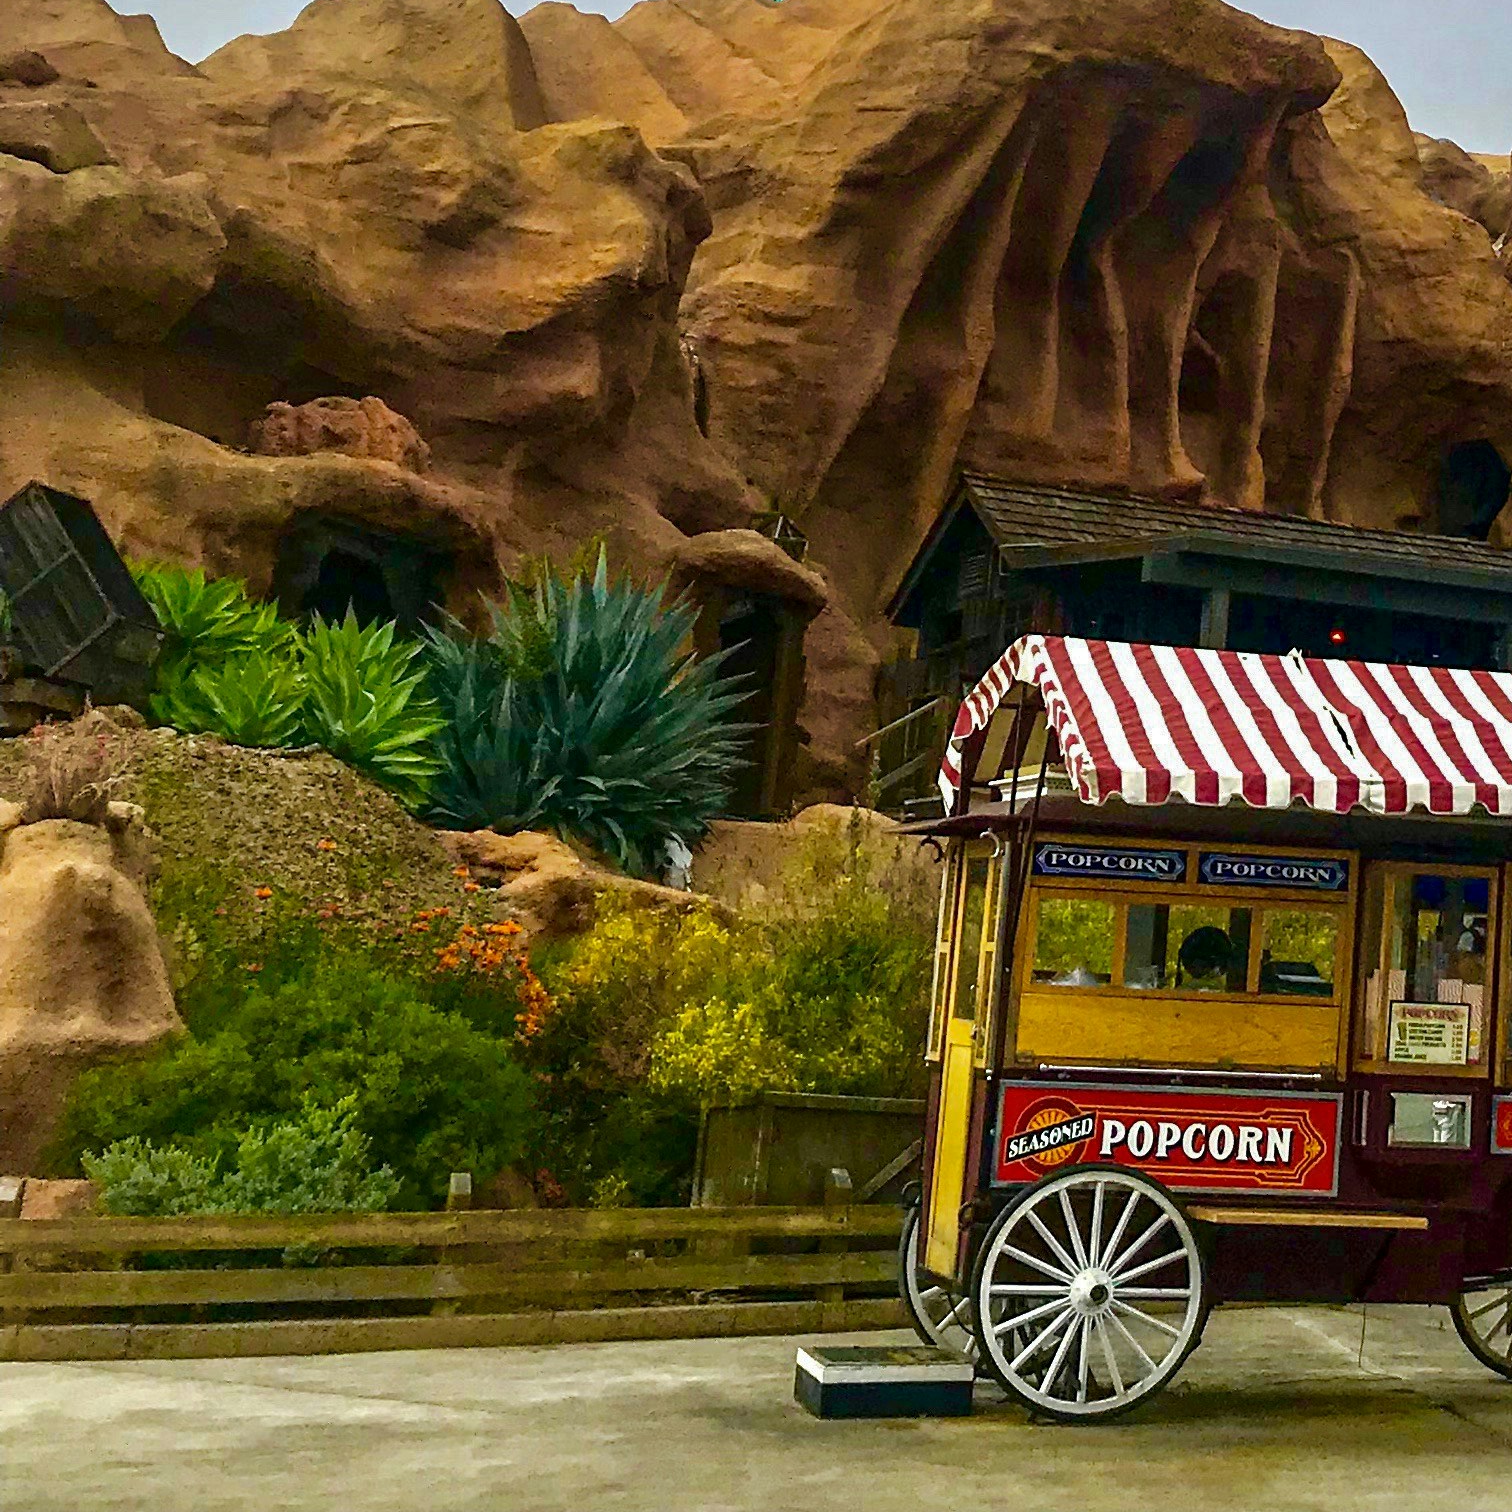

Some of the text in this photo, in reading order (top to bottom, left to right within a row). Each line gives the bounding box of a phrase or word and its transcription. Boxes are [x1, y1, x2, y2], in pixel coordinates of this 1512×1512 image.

[1050, 851, 1170, 874] POPCORN
[1216, 861, 1331, 883] POPCORN
[1008, 1116, 1293, 1163] SEASONED POPCORN
